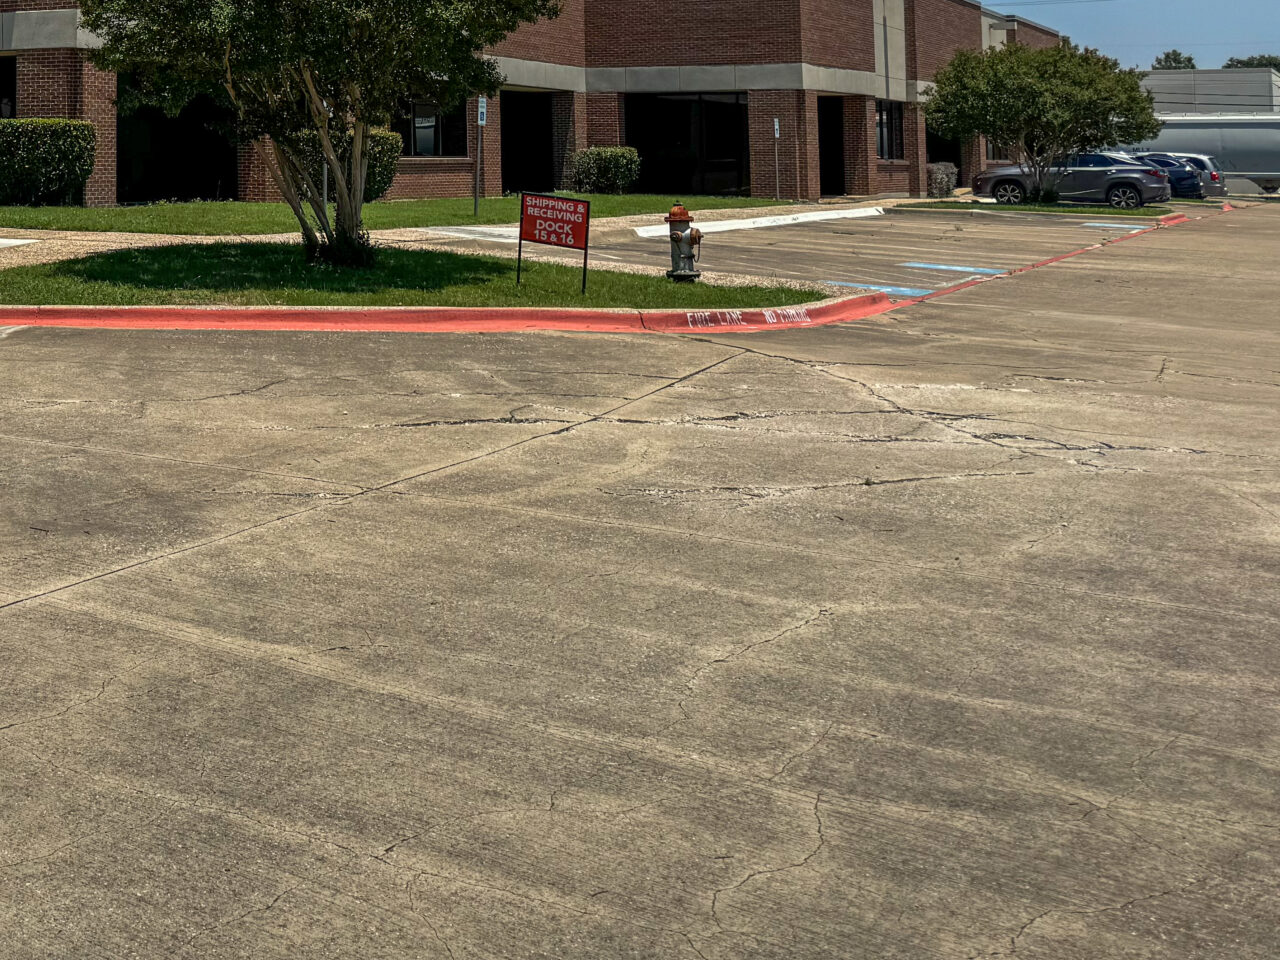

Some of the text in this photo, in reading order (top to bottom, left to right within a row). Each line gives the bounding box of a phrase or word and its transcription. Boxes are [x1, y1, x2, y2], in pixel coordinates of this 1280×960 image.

[526, 197, 585, 213] SHIPPING &
[527, 207, 583, 223] RECEIVING
[536, 220, 573, 234] DOCK
[534, 230, 574, 245] 15 & 16
[686, 311, 715, 328] FIRE
[716, 310, 748, 326] LANE
[762, 309, 778, 323] NO
